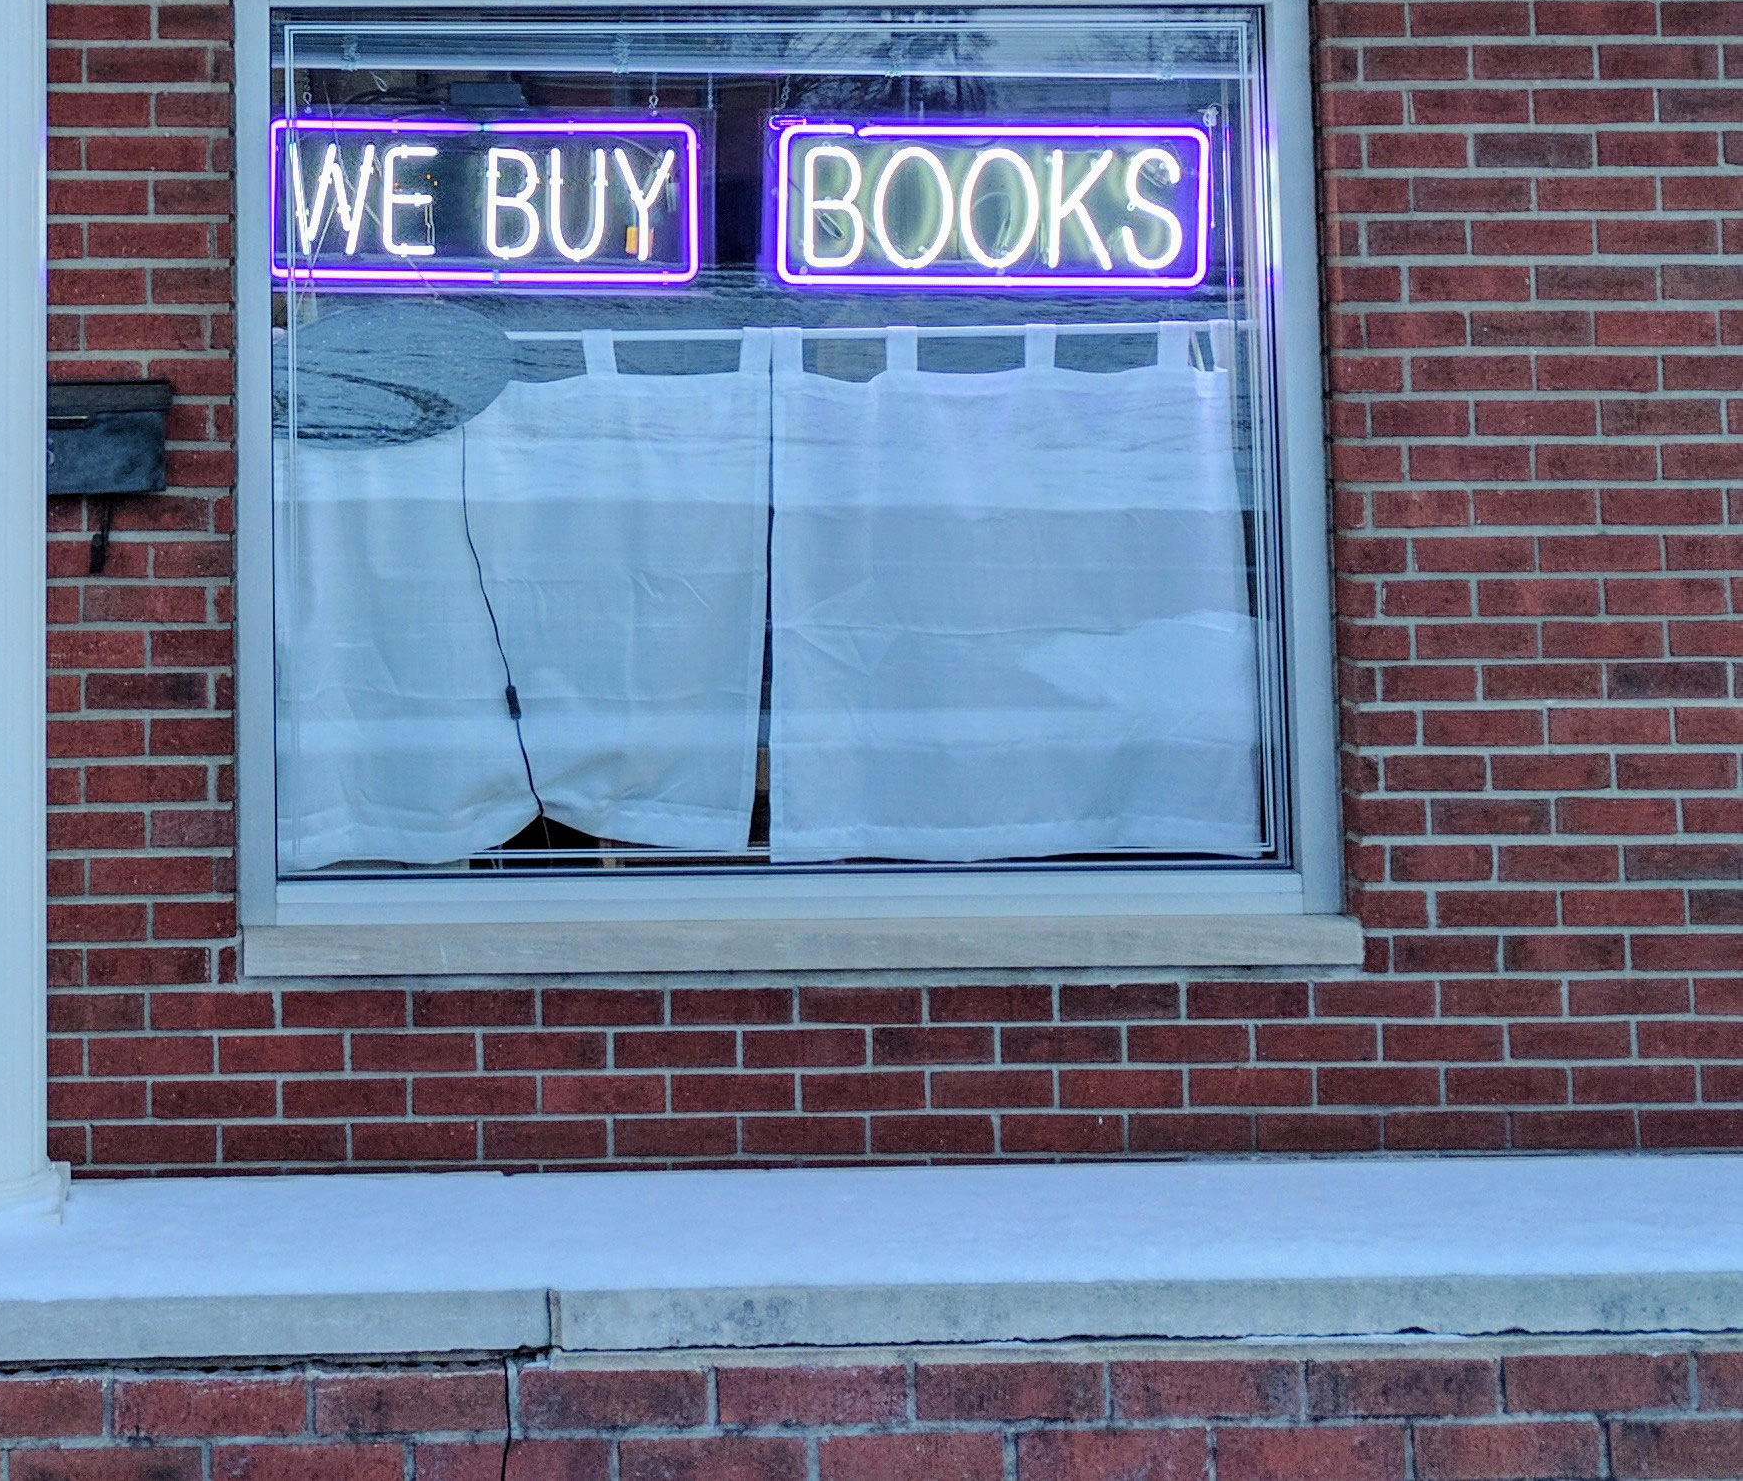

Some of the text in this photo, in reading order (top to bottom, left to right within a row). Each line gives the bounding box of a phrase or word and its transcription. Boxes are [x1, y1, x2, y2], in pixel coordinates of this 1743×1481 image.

[289, 142, 1184, 271] WE BUY BOOKS
